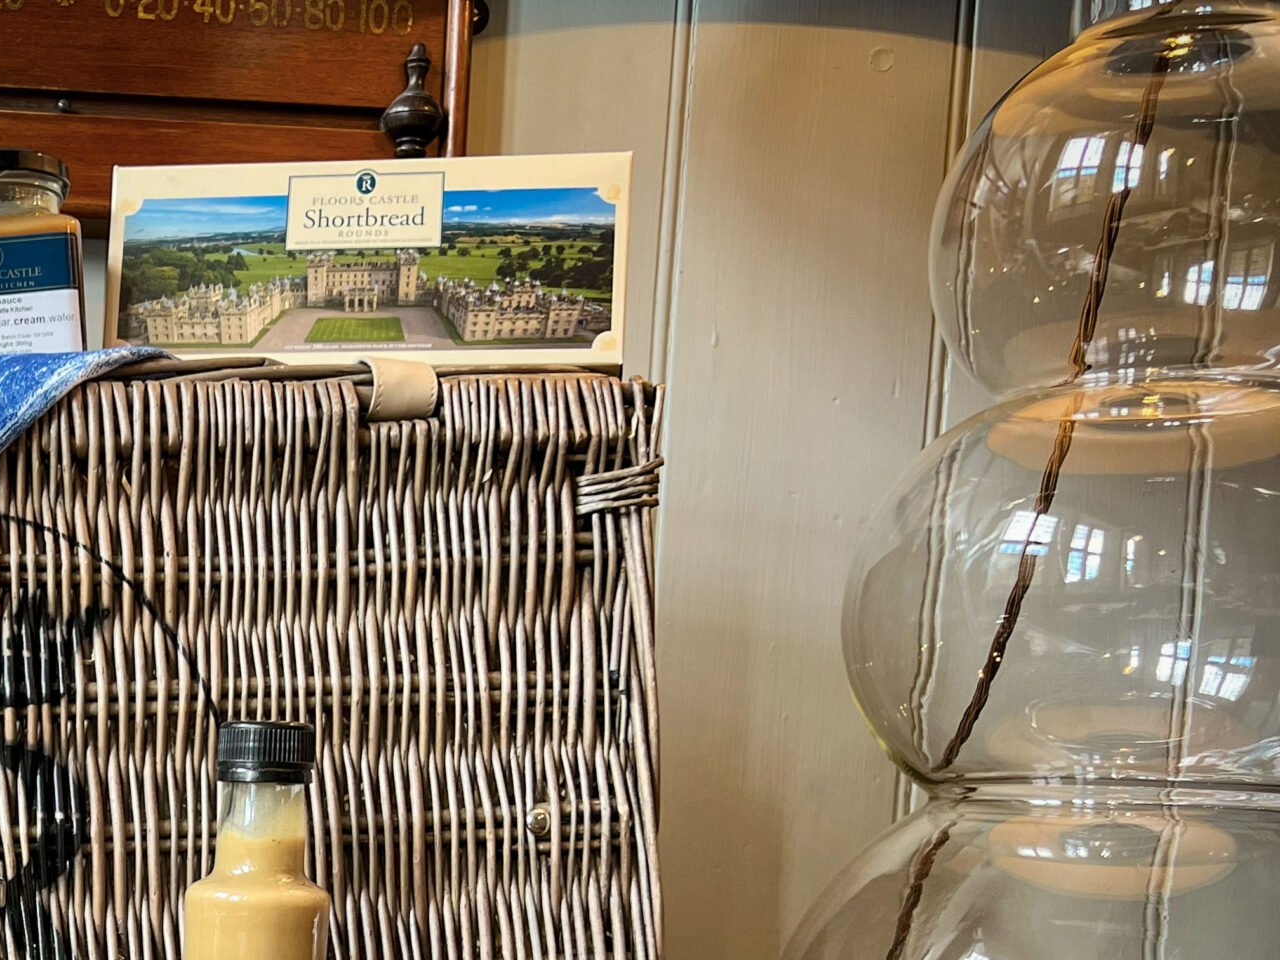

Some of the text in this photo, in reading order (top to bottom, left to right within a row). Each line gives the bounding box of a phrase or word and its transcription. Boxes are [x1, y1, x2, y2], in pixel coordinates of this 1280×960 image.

[312, 195, 418, 206] FLOORS CASTLE
[303, 206, 424, 229] Shortbread
[338, 230, 389, 238] ROUNDS
